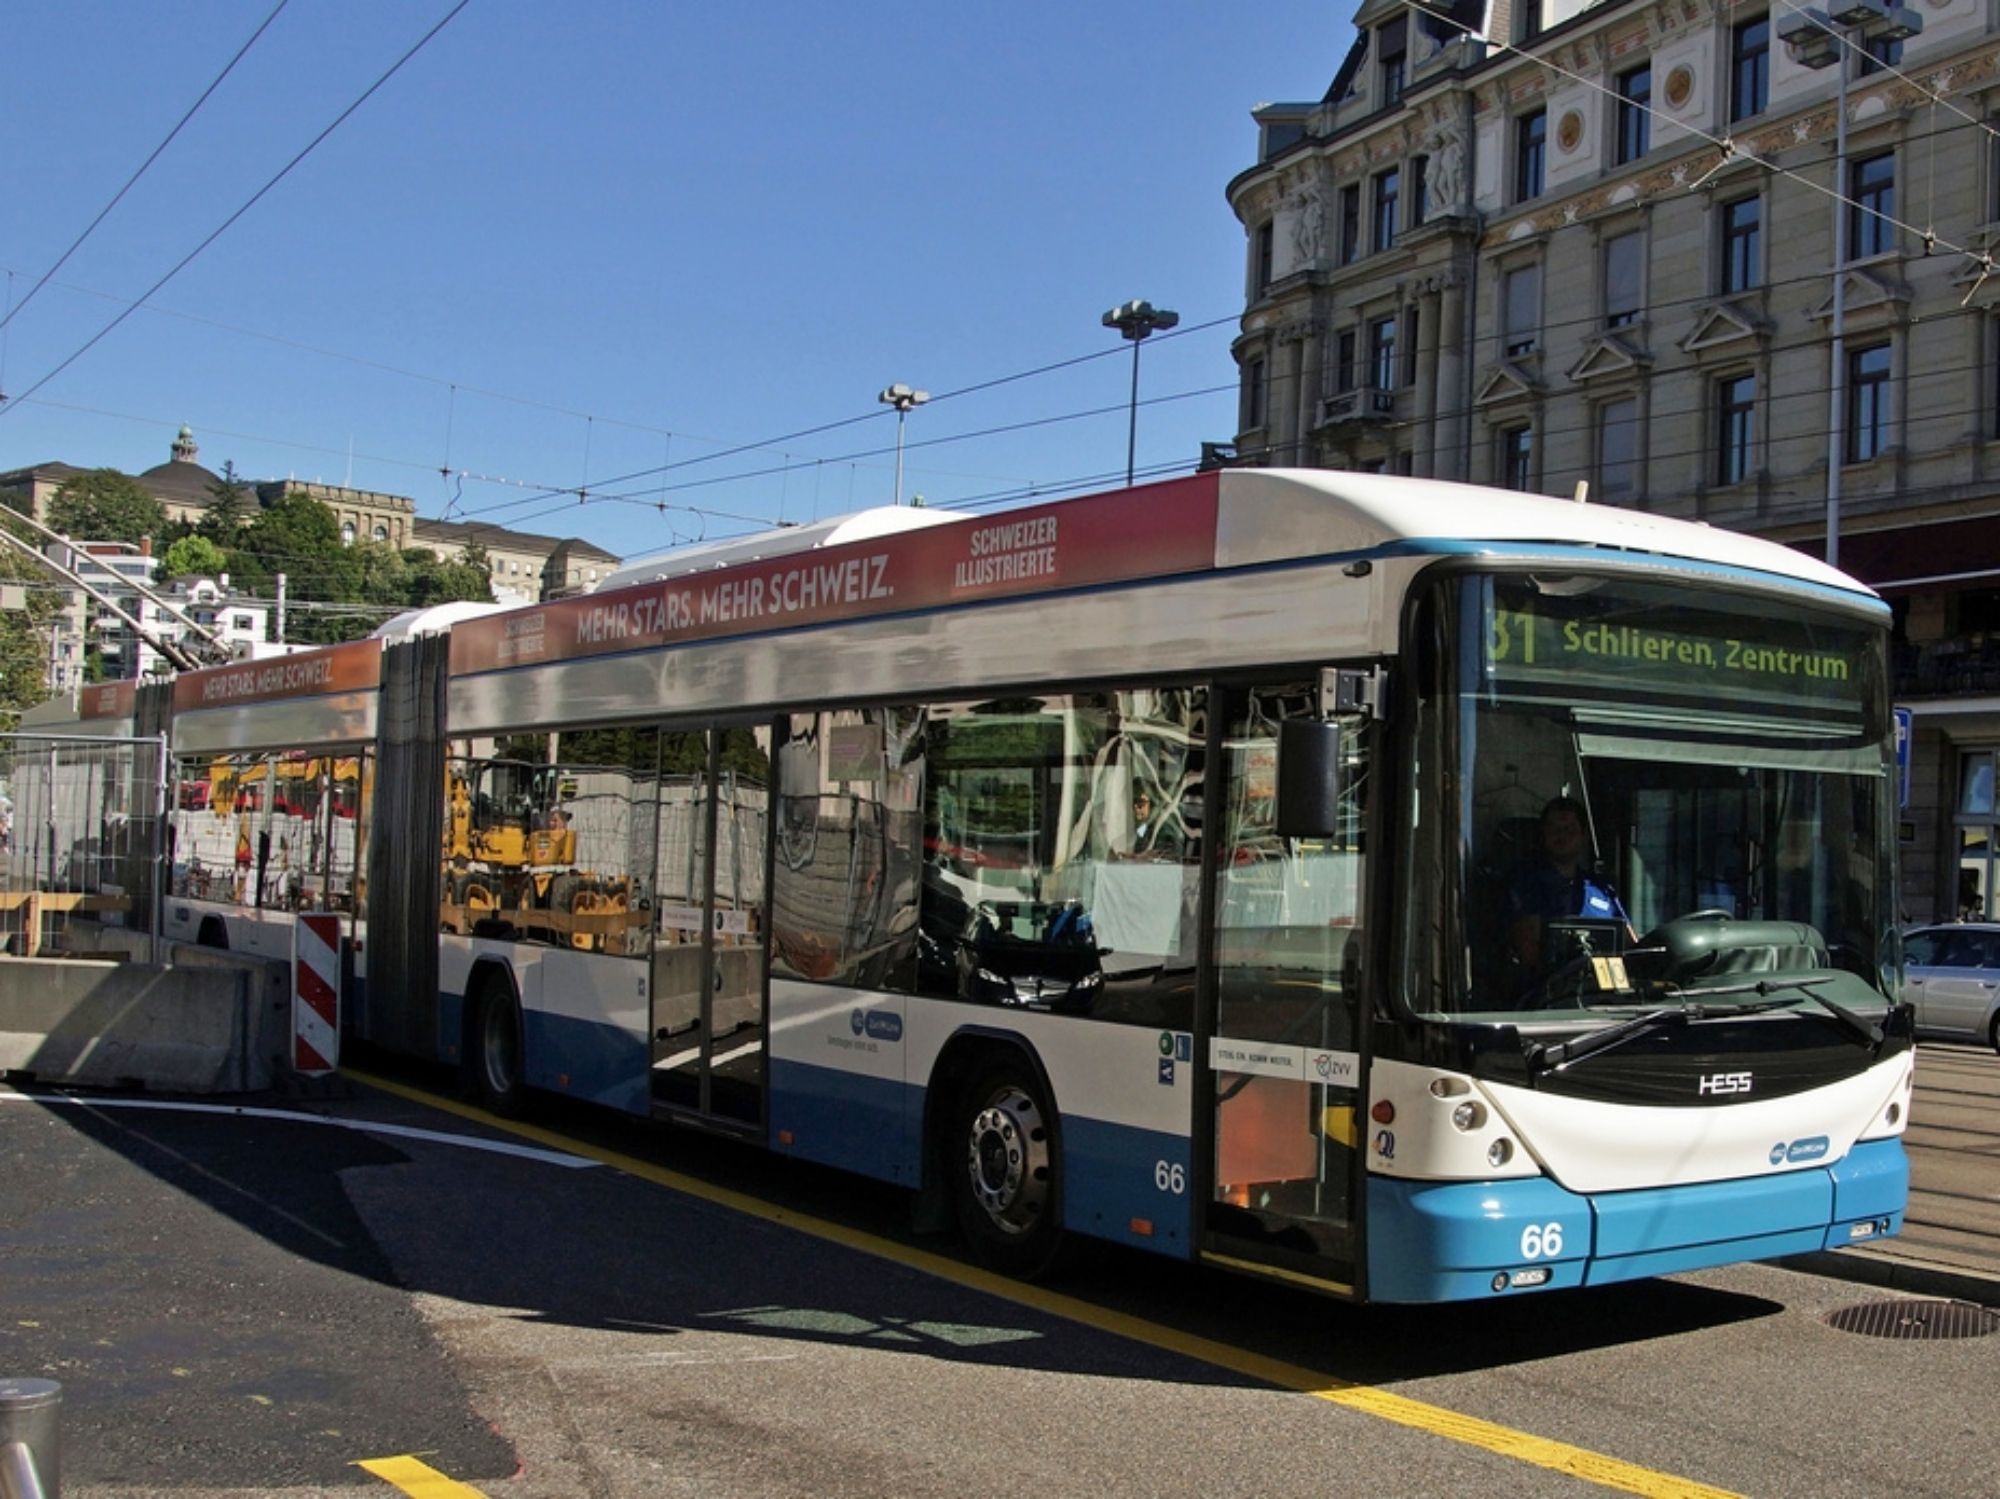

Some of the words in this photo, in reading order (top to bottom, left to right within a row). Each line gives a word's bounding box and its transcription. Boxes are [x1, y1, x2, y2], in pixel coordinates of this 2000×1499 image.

[970, 516, 1057, 557] SCHWEIZER
[955, 547, 1056, 588] ILLUSTRIERTE
[576, 605, 628, 645] MEHR
[632, 591, 695, 636] STARS.
[700, 579, 764, 625] MEHR
[769, 554, 894, 616] SCHWEIZ.
[1486, 606, 1535, 664] 31
[1563, 618, 1718, 669] Schlieren,
[1725, 639, 1849, 681] Zentrum
[1698, 1071, 1753, 1096] HESS
[1154, 1159, 1186, 1195] 66
[1520, 1221, 1563, 1260] 66
